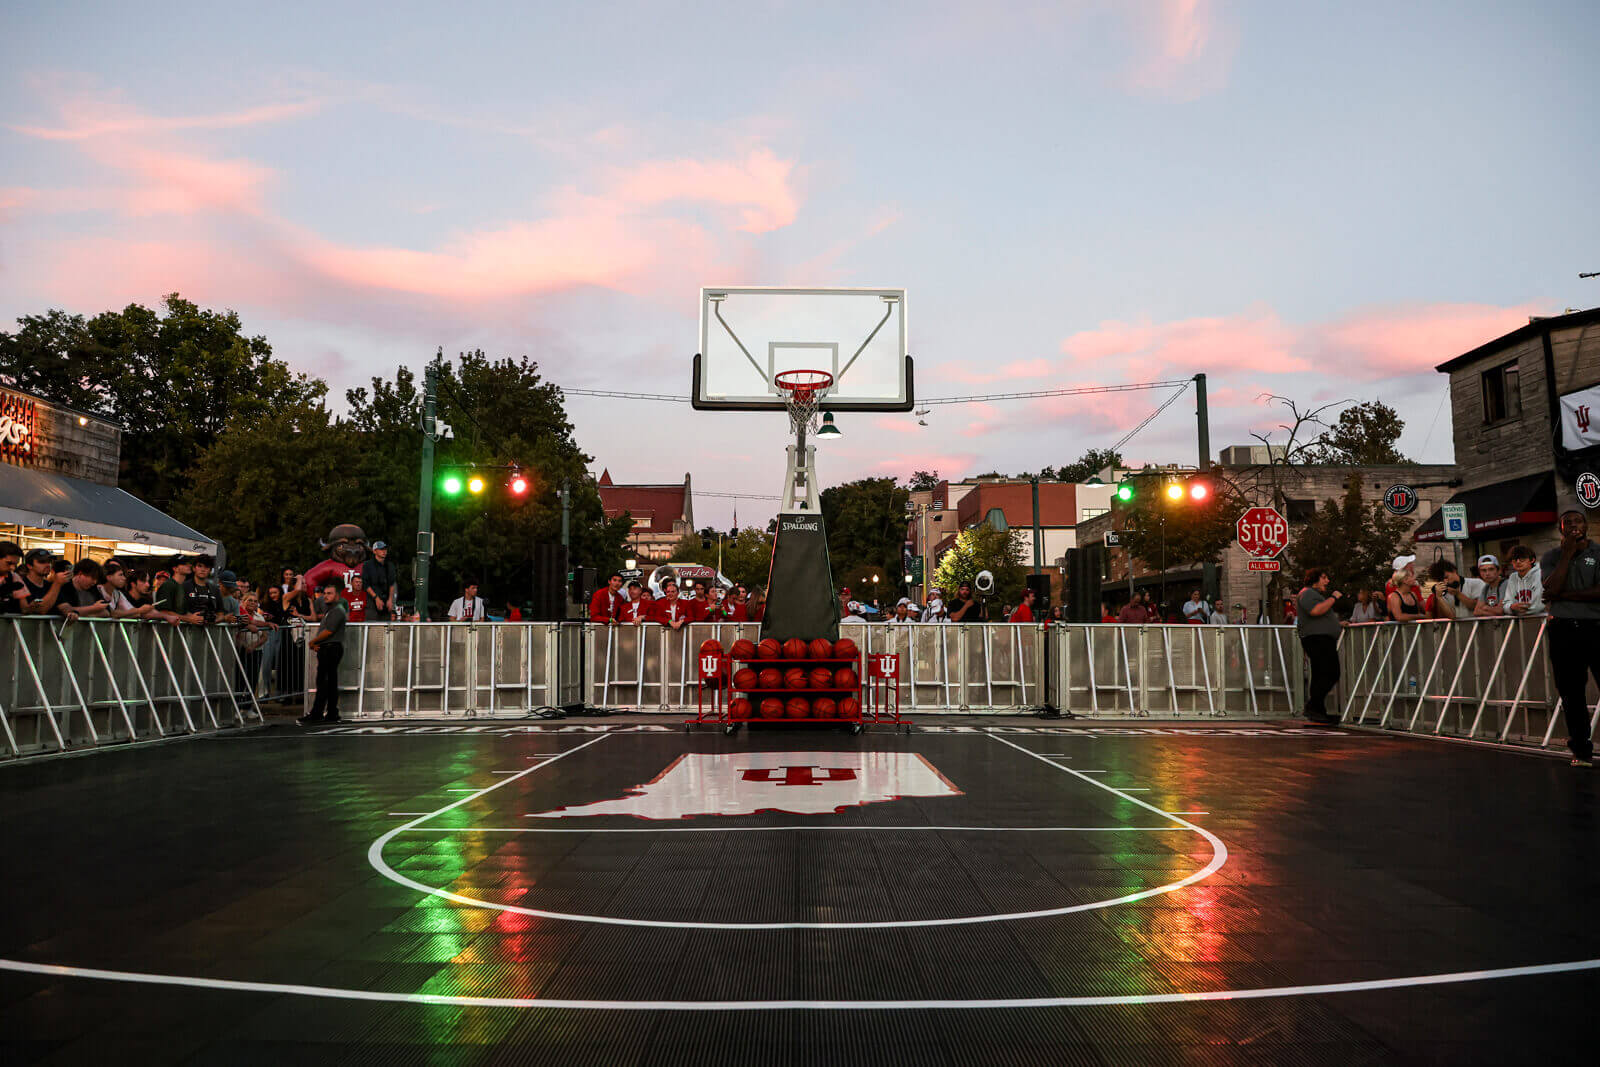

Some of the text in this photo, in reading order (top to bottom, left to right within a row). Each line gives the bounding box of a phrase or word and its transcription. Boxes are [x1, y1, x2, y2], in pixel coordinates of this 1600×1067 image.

[782, 522, 818, 531] SPALDING
[1241, 524, 1284, 542] STOP
[306, 725, 1349, 736] INDIANA HOOSIERS
